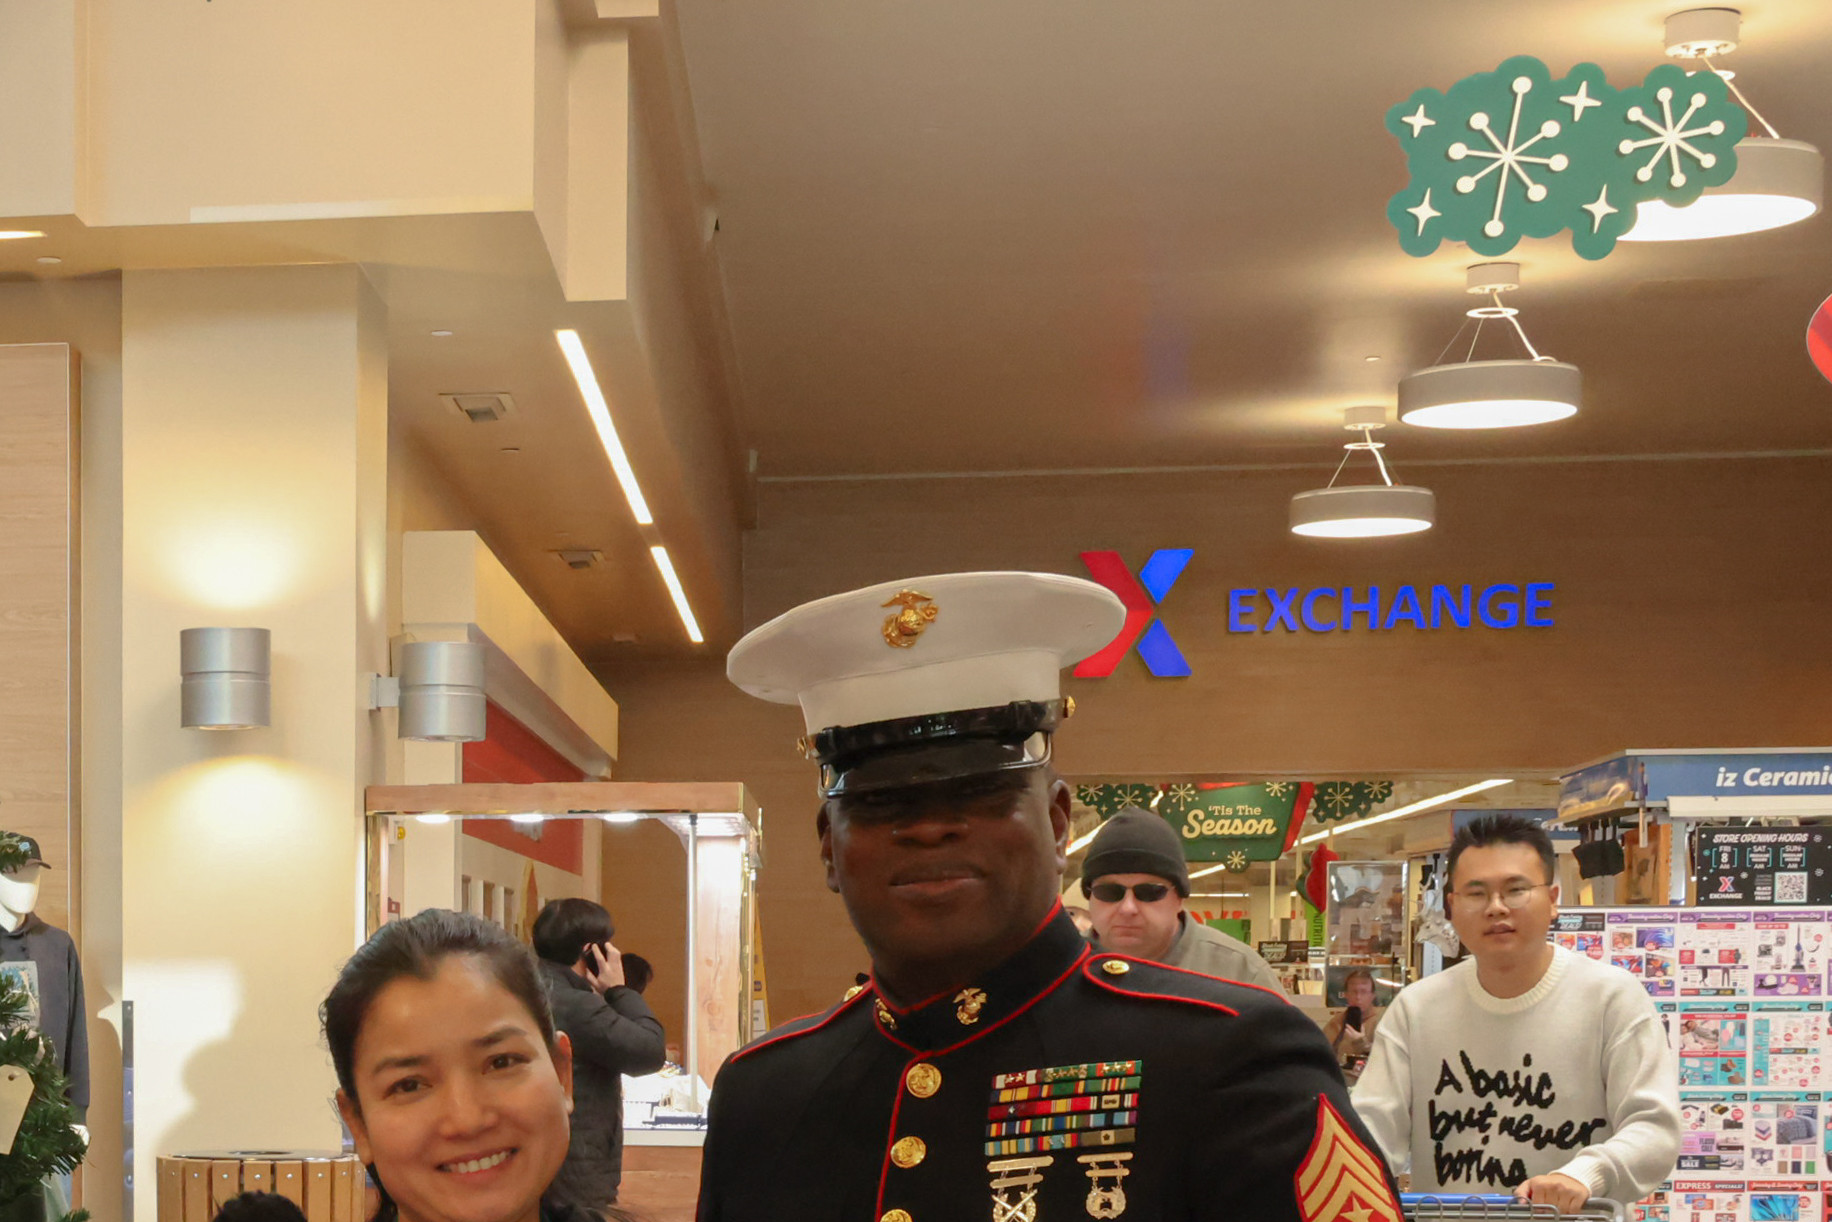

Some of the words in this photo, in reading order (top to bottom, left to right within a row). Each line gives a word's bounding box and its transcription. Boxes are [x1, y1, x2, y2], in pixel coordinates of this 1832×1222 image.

[1228, 581, 1555, 634] EXCHANGE
[1716, 766, 1738, 787] iz
[1236, 804, 1262, 815] The
[1182, 808, 1277, 838] Season
[1713, 834, 1739, 843] STORE
[1740, 833, 1777, 842] OPENING
[1778, 833, 1809, 842] HOURS
[1435, 1058, 1463, 1095] A
[1460, 1050, 1555, 1109] basic
[1429, 1099, 1498, 1141] but
[1498, 1113, 1607, 1150] never
[1681, 1160, 1700, 1168] SALE
[1676, 1182, 1712, 1190] EXPRESS
